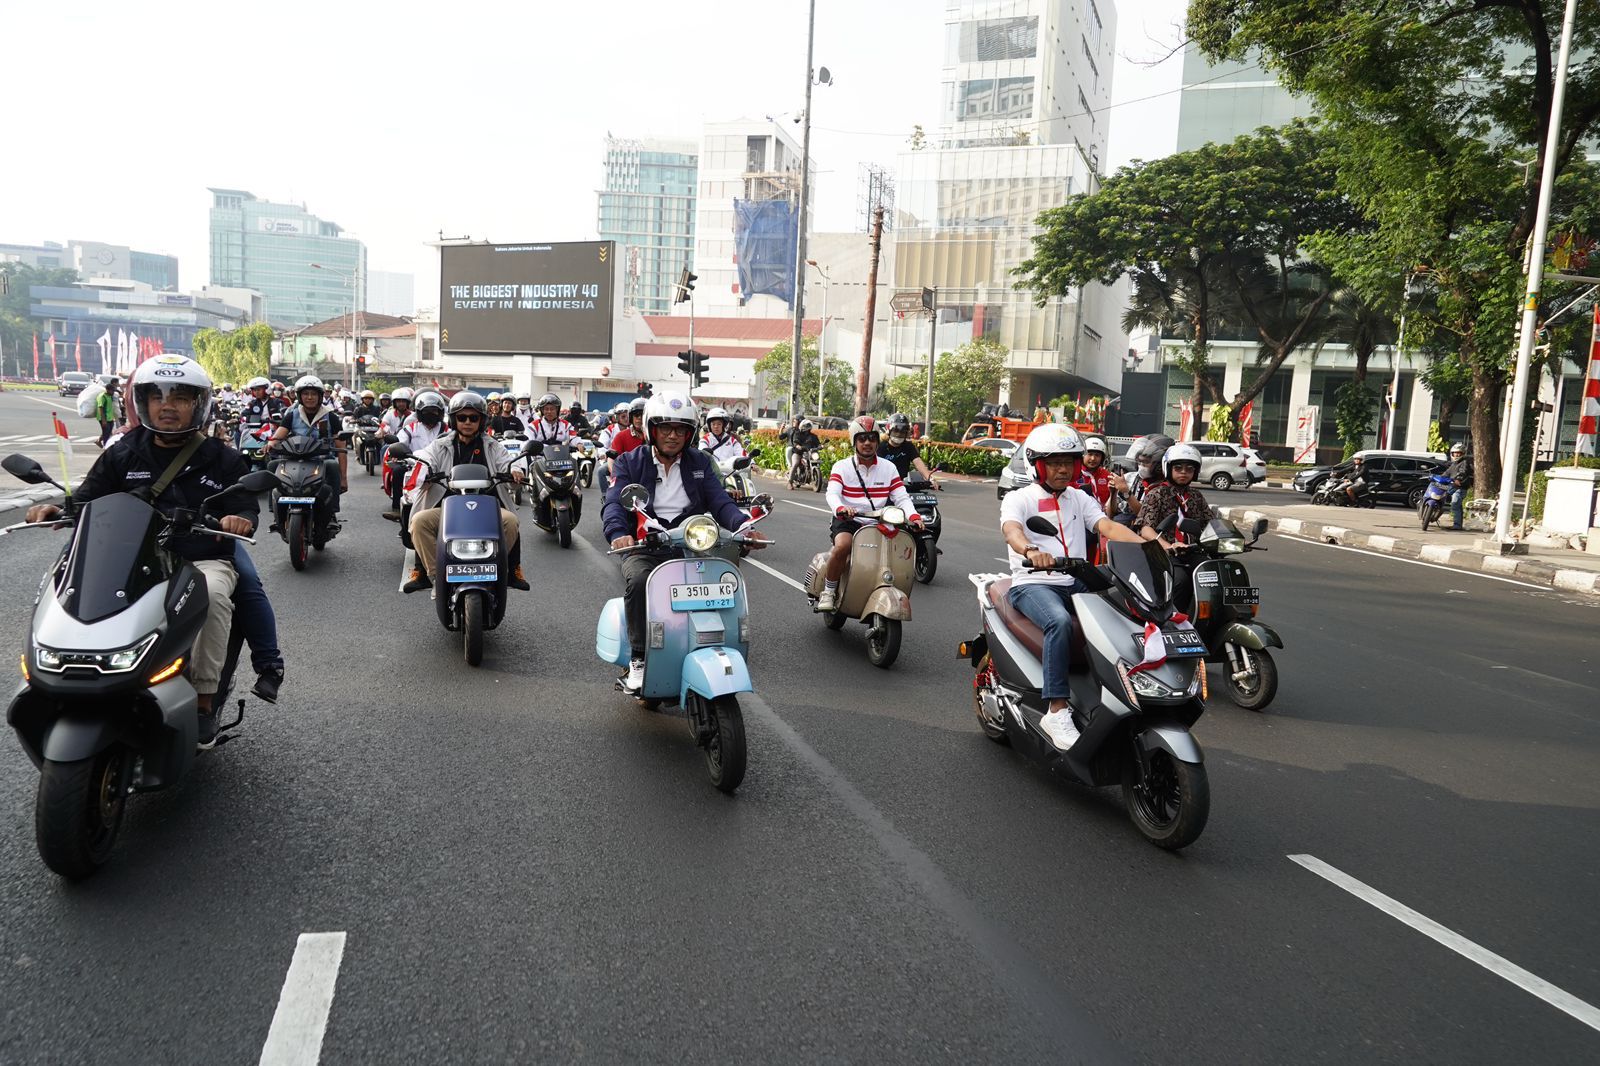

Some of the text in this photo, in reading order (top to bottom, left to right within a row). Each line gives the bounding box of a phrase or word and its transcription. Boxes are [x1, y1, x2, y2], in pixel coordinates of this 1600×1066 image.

[450, 285, 470, 298] THE
[472, 284, 519, 298] BIGGEST
[521, 284, 578, 298] INDUSTRY
[454, 300, 595, 309] EVENT IN INDONESIA
[449, 566, 454, 574] B
[673, 585, 731, 597] B 3510 KG
[1232, 588, 1248, 597] 5773
